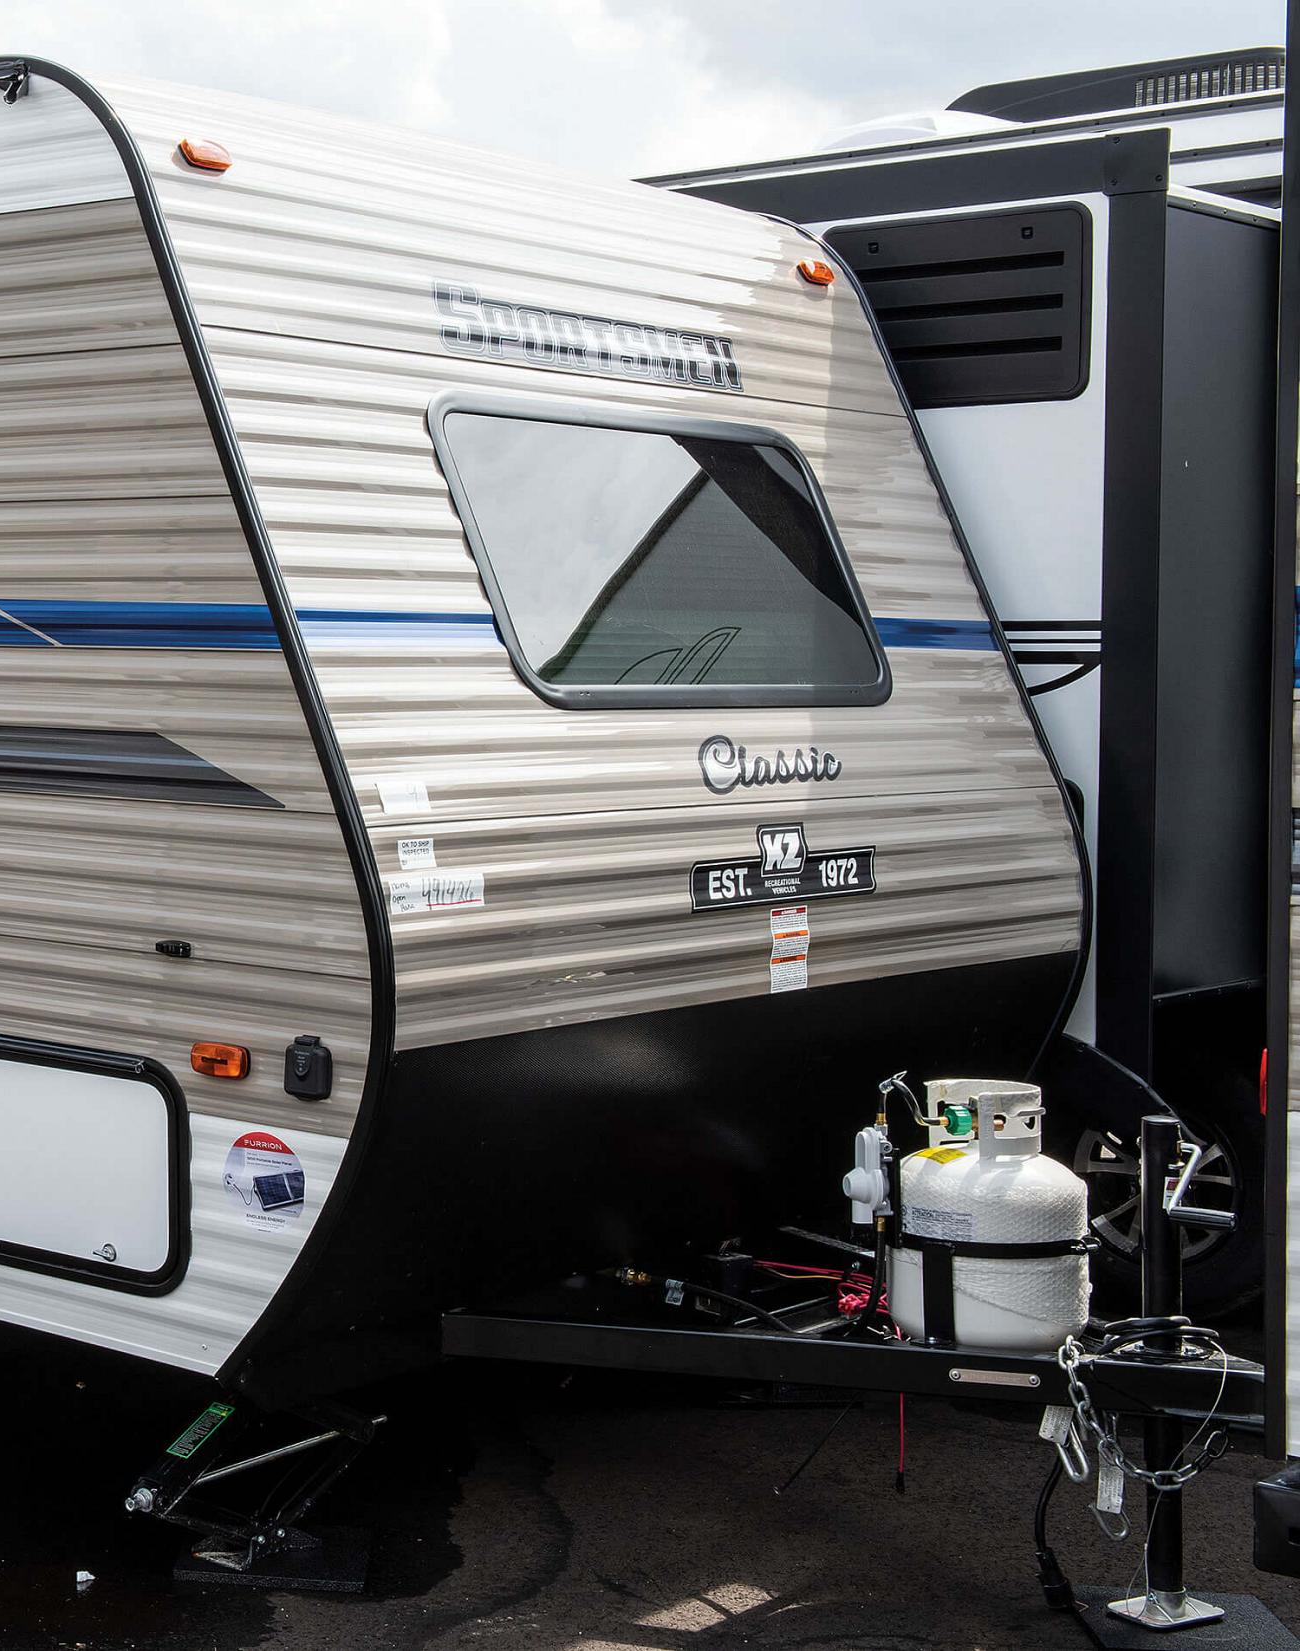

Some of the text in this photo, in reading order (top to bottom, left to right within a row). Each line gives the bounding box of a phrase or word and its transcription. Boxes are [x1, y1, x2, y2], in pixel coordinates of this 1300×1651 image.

[431, 278, 744, 392] SPORTSMEN
[698, 734, 843, 796] Classic
[708, 857, 859, 900] EST. 1972
[764, 877, 802, 889] RECREATIONAL
[772, 886, 797, 896] VEHICLES
[243, 1139, 283, 1151] FURRION
